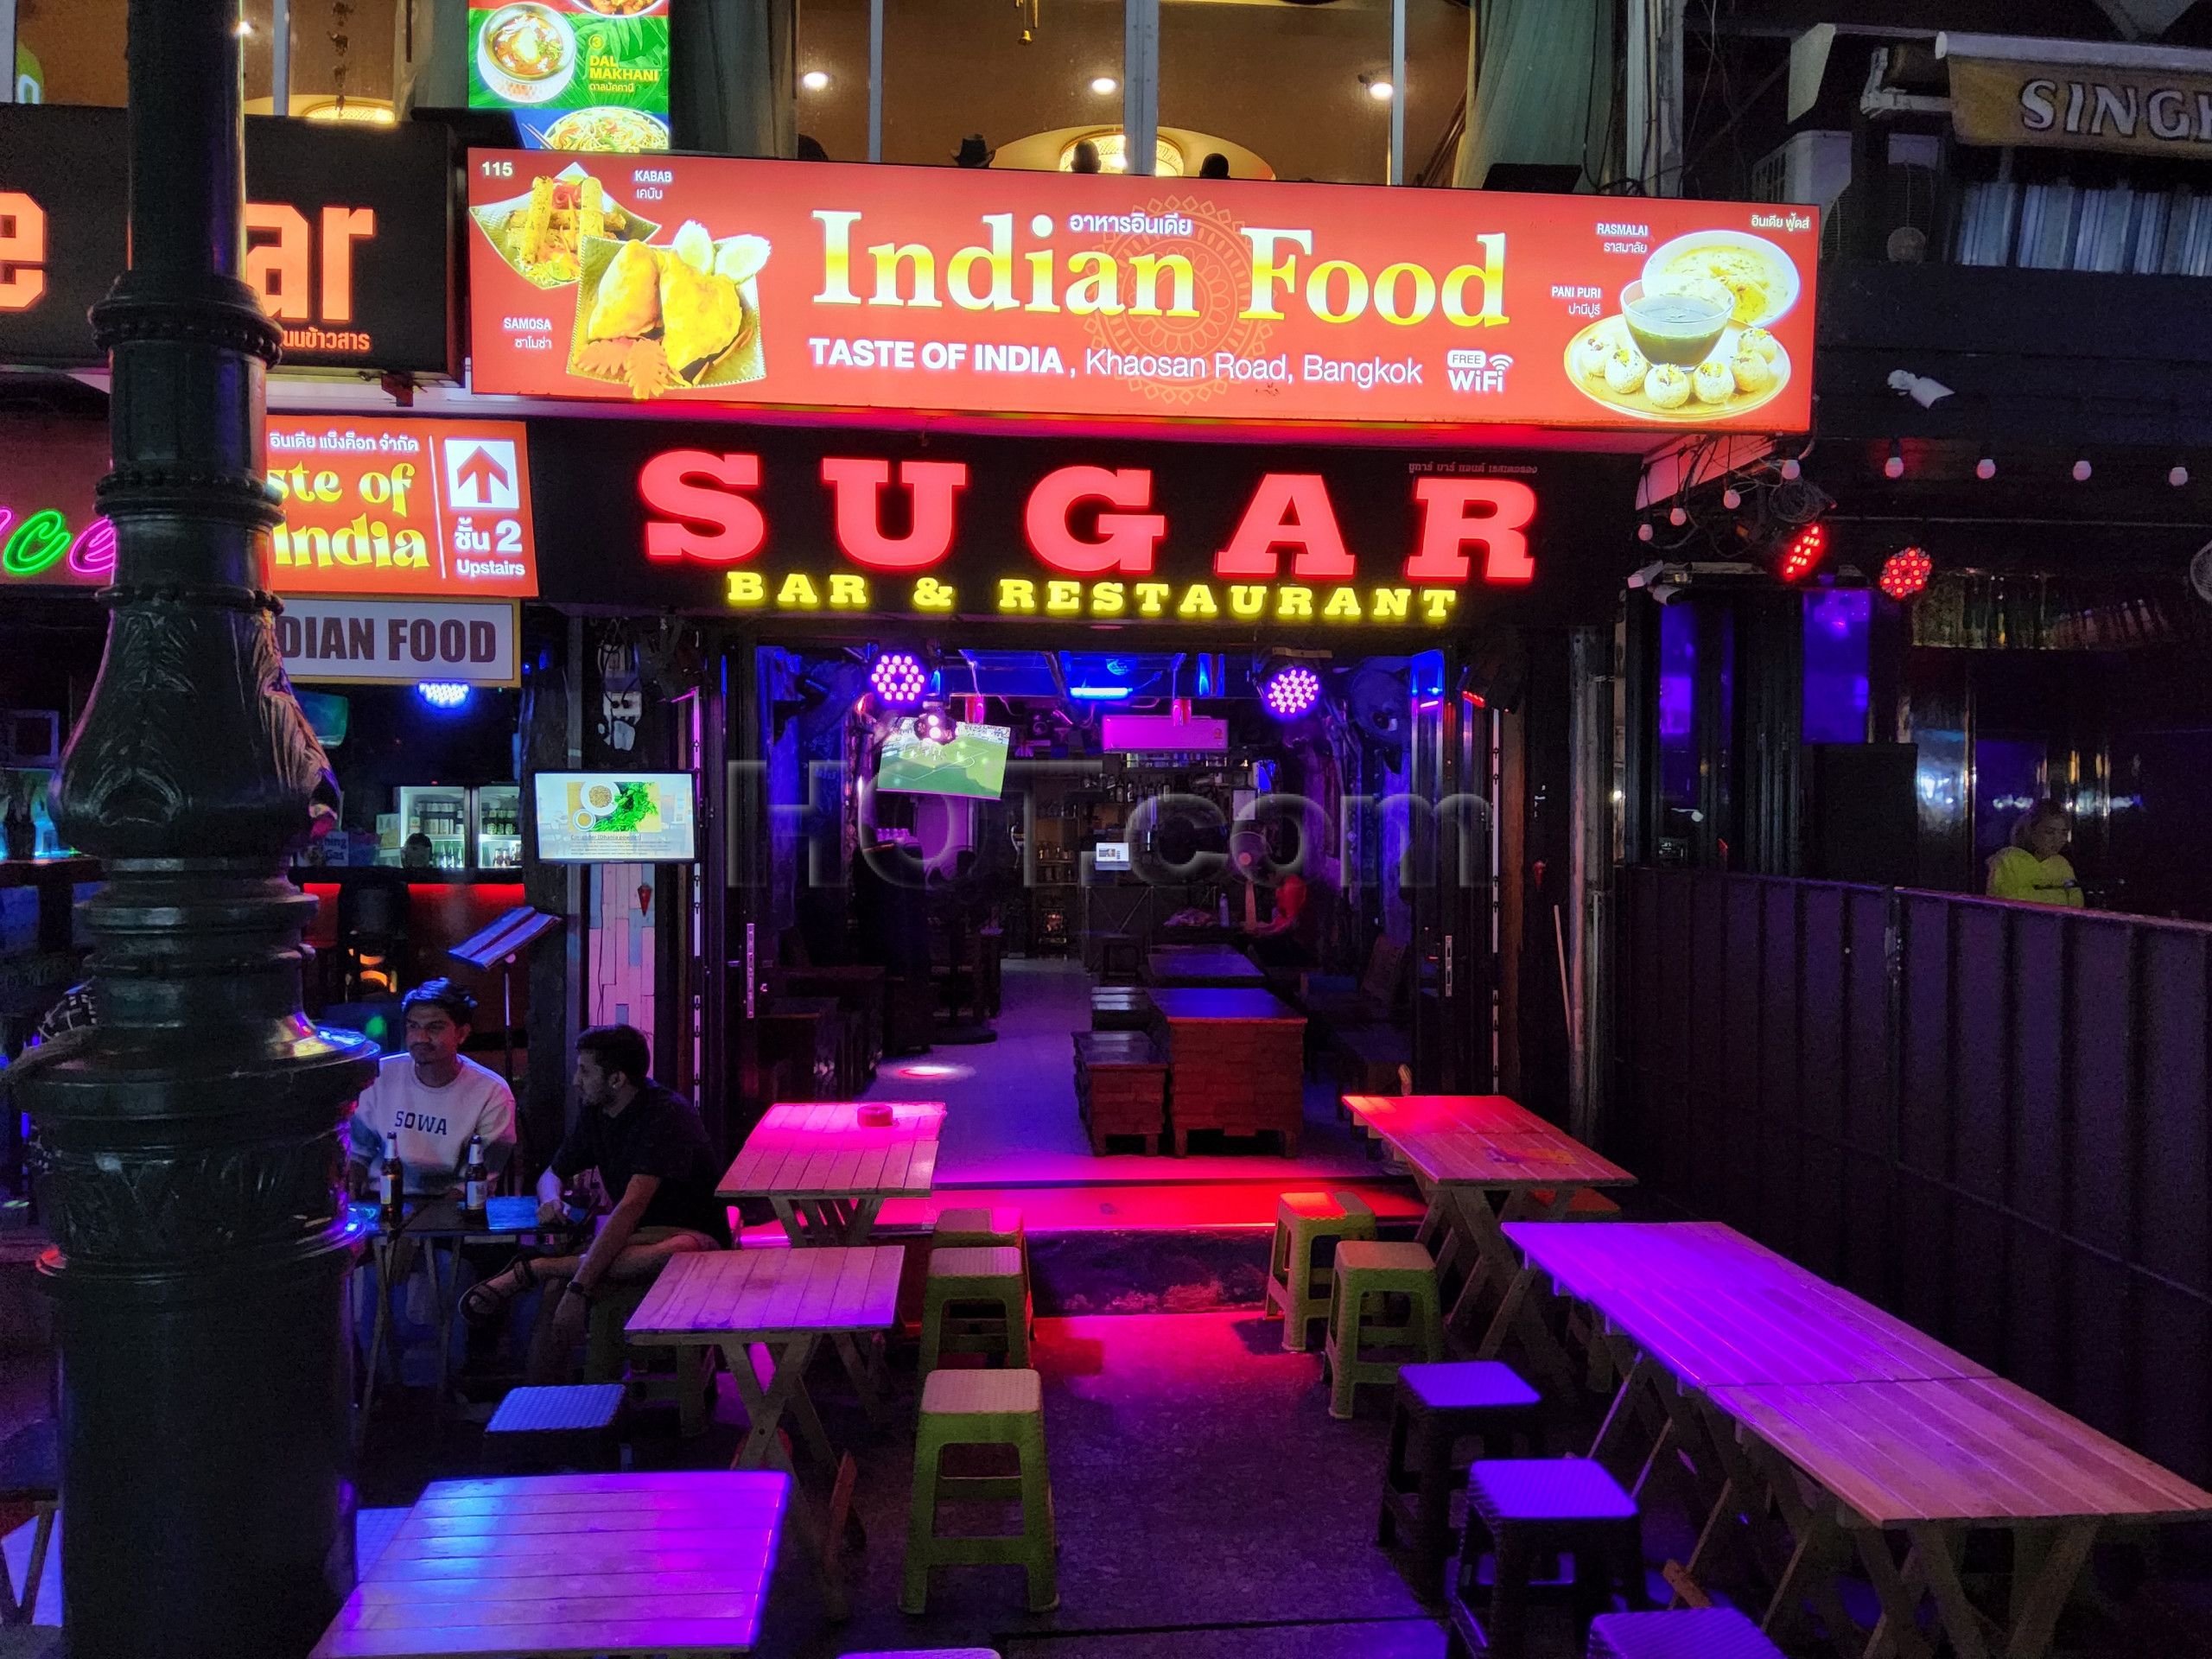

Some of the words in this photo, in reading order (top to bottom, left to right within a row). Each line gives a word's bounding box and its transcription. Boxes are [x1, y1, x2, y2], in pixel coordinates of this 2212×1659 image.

[589, 54, 619, 67] DAL
[589, 67, 659, 81] MAKHANI
[482, 162, 513, 177] 115
[634, 170, 672, 182] KABAB
[1070, 212, 1193, 236] อาหารอินเดีย
[1597, 223, 1649, 236] RASMALAI
[1751, 215, 1783, 228] อินเดีย
[1604, 241, 1647, 253] ราสมาลัย
[246, 203, 375, 321] ar
[811, 210, 1201, 318] Indian
[1238, 226, 1510, 327] Food
[1552, 286, 1575, 297] PANI
[1577, 287, 1601, 299] PURI
[1568, 302, 1600, 318] ปานีปูรี
[504, 317, 552, 330] SAMOSA
[282, 327, 371, 351] นนข้าวสาร
[515, 335, 552, 349] ซาโมซ่า
[810, 338, 914, 368] TASTE
[922, 341, 967, 370] OF
[1085, 347, 1206, 378] Khaosan
[1215, 353, 1294, 385] Road,
[1304, 354, 1423, 389] Bangkok
[1452, 353, 1482, 365] FREE
[1446, 369, 1504, 393] WiFi
[270, 432, 316, 449] อินเดีย
[380, 432, 419, 452] จำกัด
[266, 461, 343, 502] ste
[359, 462, 416, 518] of
[639, 449, 1535, 579] SUGAR
[272, 511, 430, 569] India
[454, 517, 491, 551] ชั้น
[494, 520, 523, 552] 2
[456, 558, 526, 576] Upstairs
[727, 571, 868, 605] BAR
[913, 577, 953, 607] &
[999, 579, 1457, 618] RESTAURANT
[278, 616, 375, 661] DIAN
[388, 618, 497, 664] FOOD
[394, 1110, 448, 1135] SOWA
